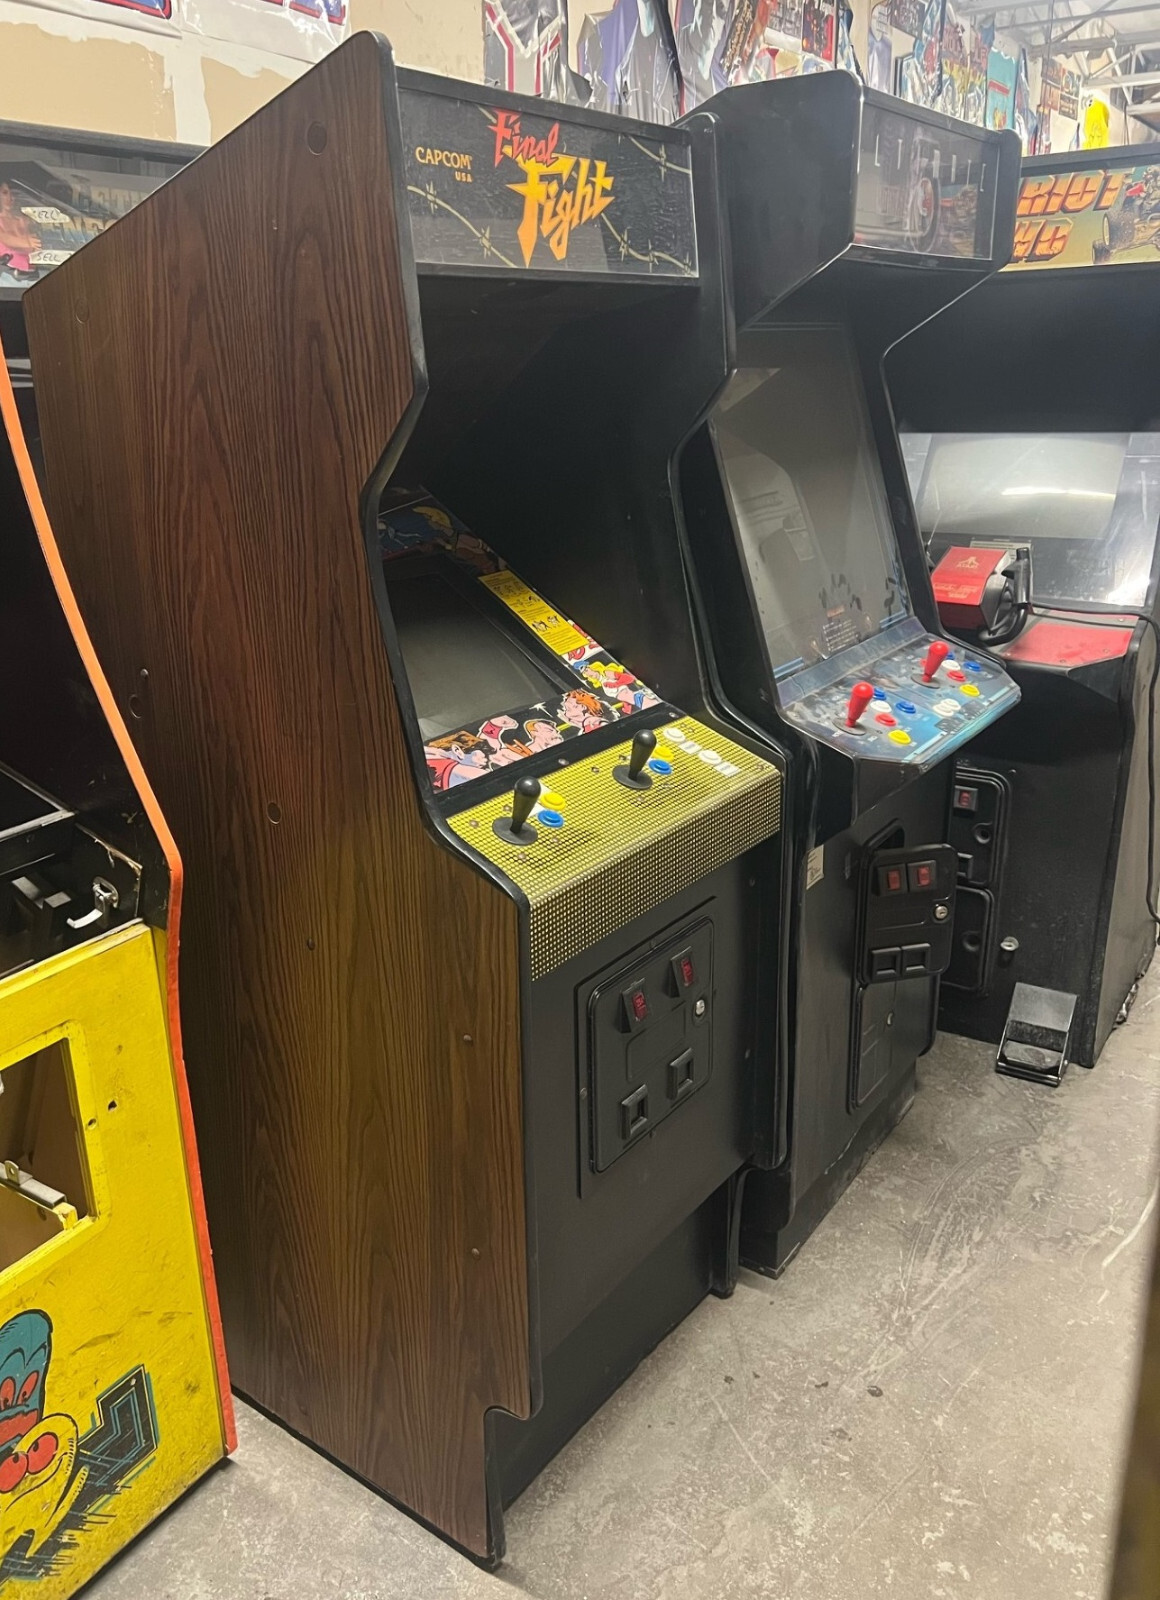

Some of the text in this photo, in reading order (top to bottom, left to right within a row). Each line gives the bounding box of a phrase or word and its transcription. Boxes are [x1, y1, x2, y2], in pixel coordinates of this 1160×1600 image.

[415, 146, 472, 170] CAPCOM
[487, 108, 561, 168] Final
[455, 171, 473, 183] USA
[1016, 169, 1130, 217] RIOT
[503, 148, 616, 269] Fight
